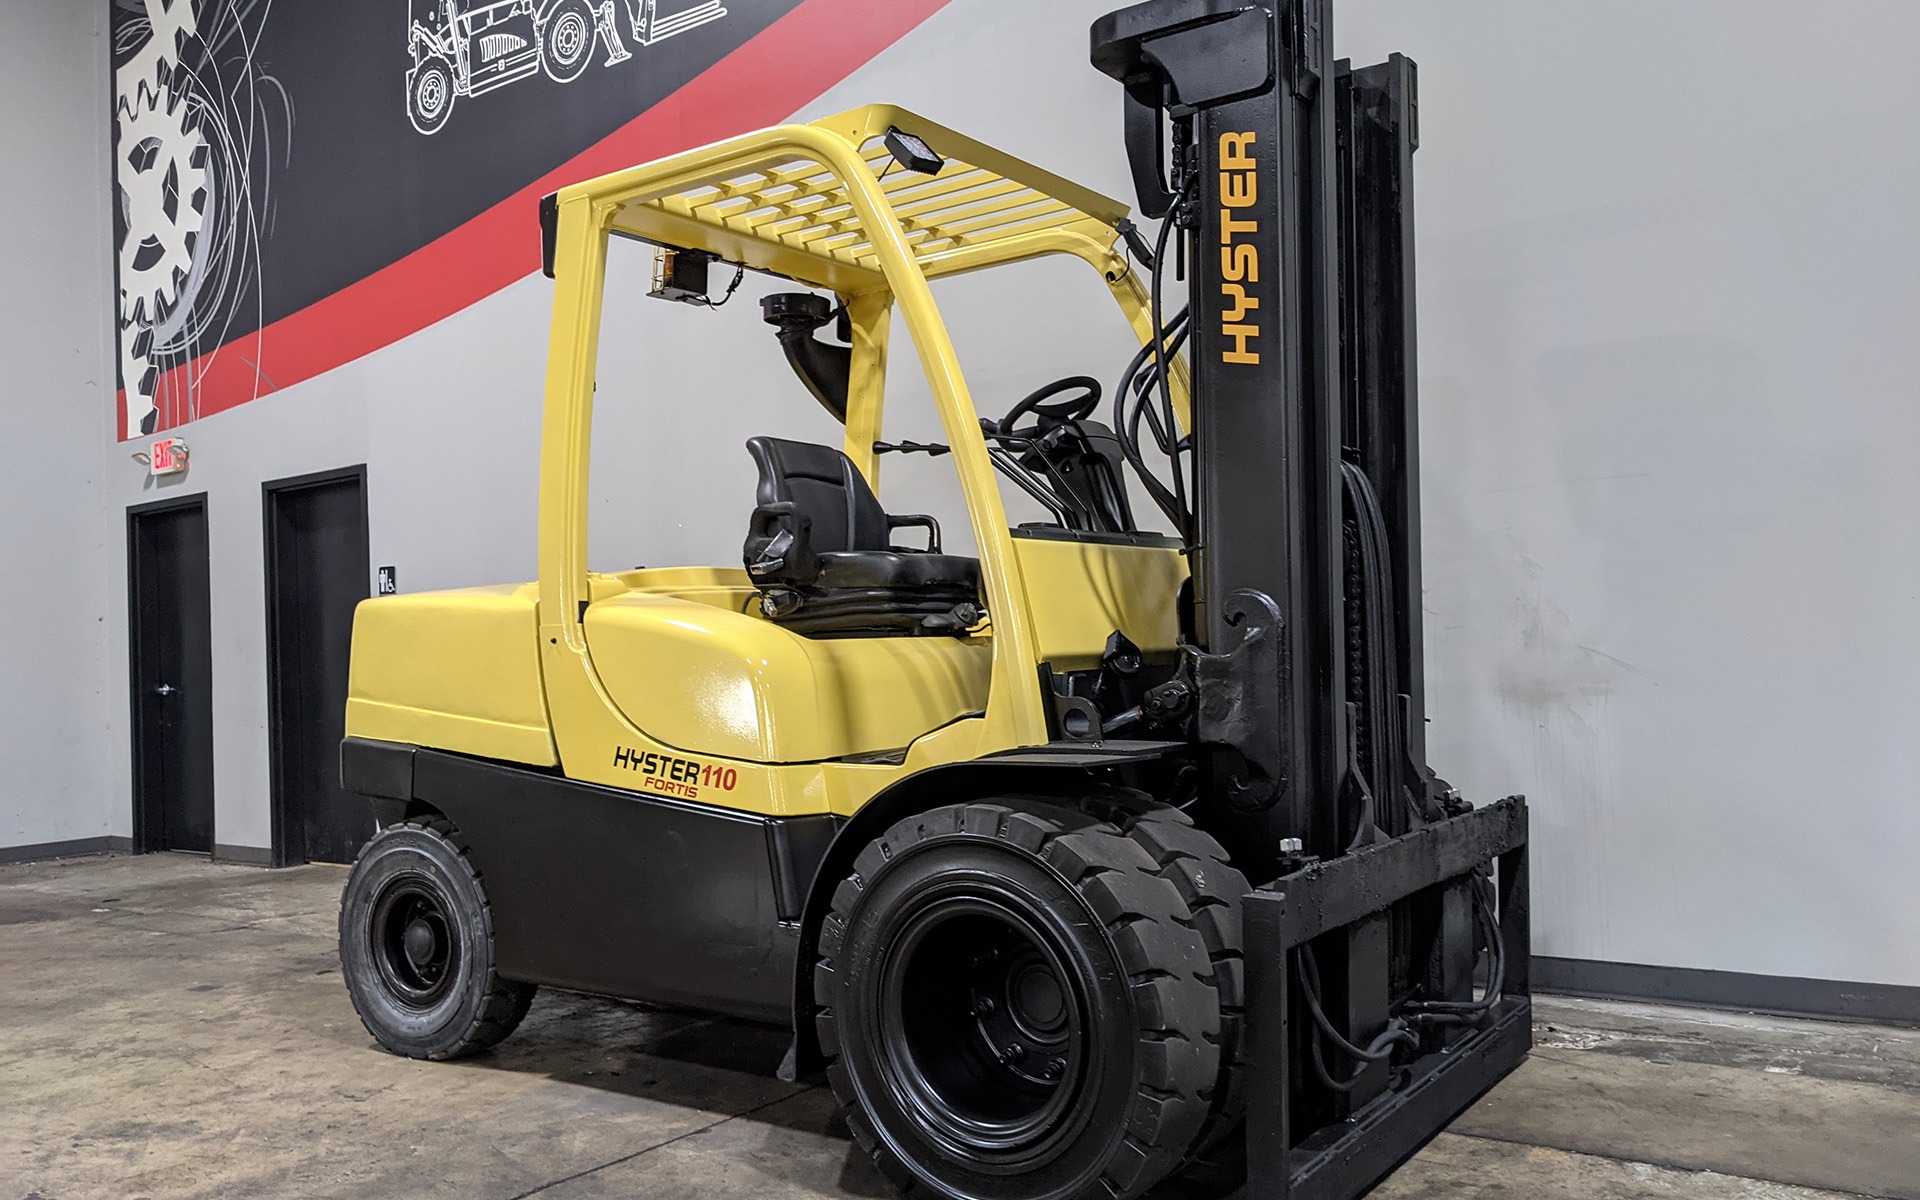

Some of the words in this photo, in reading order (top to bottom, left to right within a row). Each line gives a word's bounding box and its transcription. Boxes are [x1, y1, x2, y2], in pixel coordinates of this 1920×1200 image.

[1218, 131, 1260, 365] HYSTER
[613, 746, 701, 785] HYSTER
[701, 764, 737, 791] 110
[644, 776, 698, 798] FORTIS
